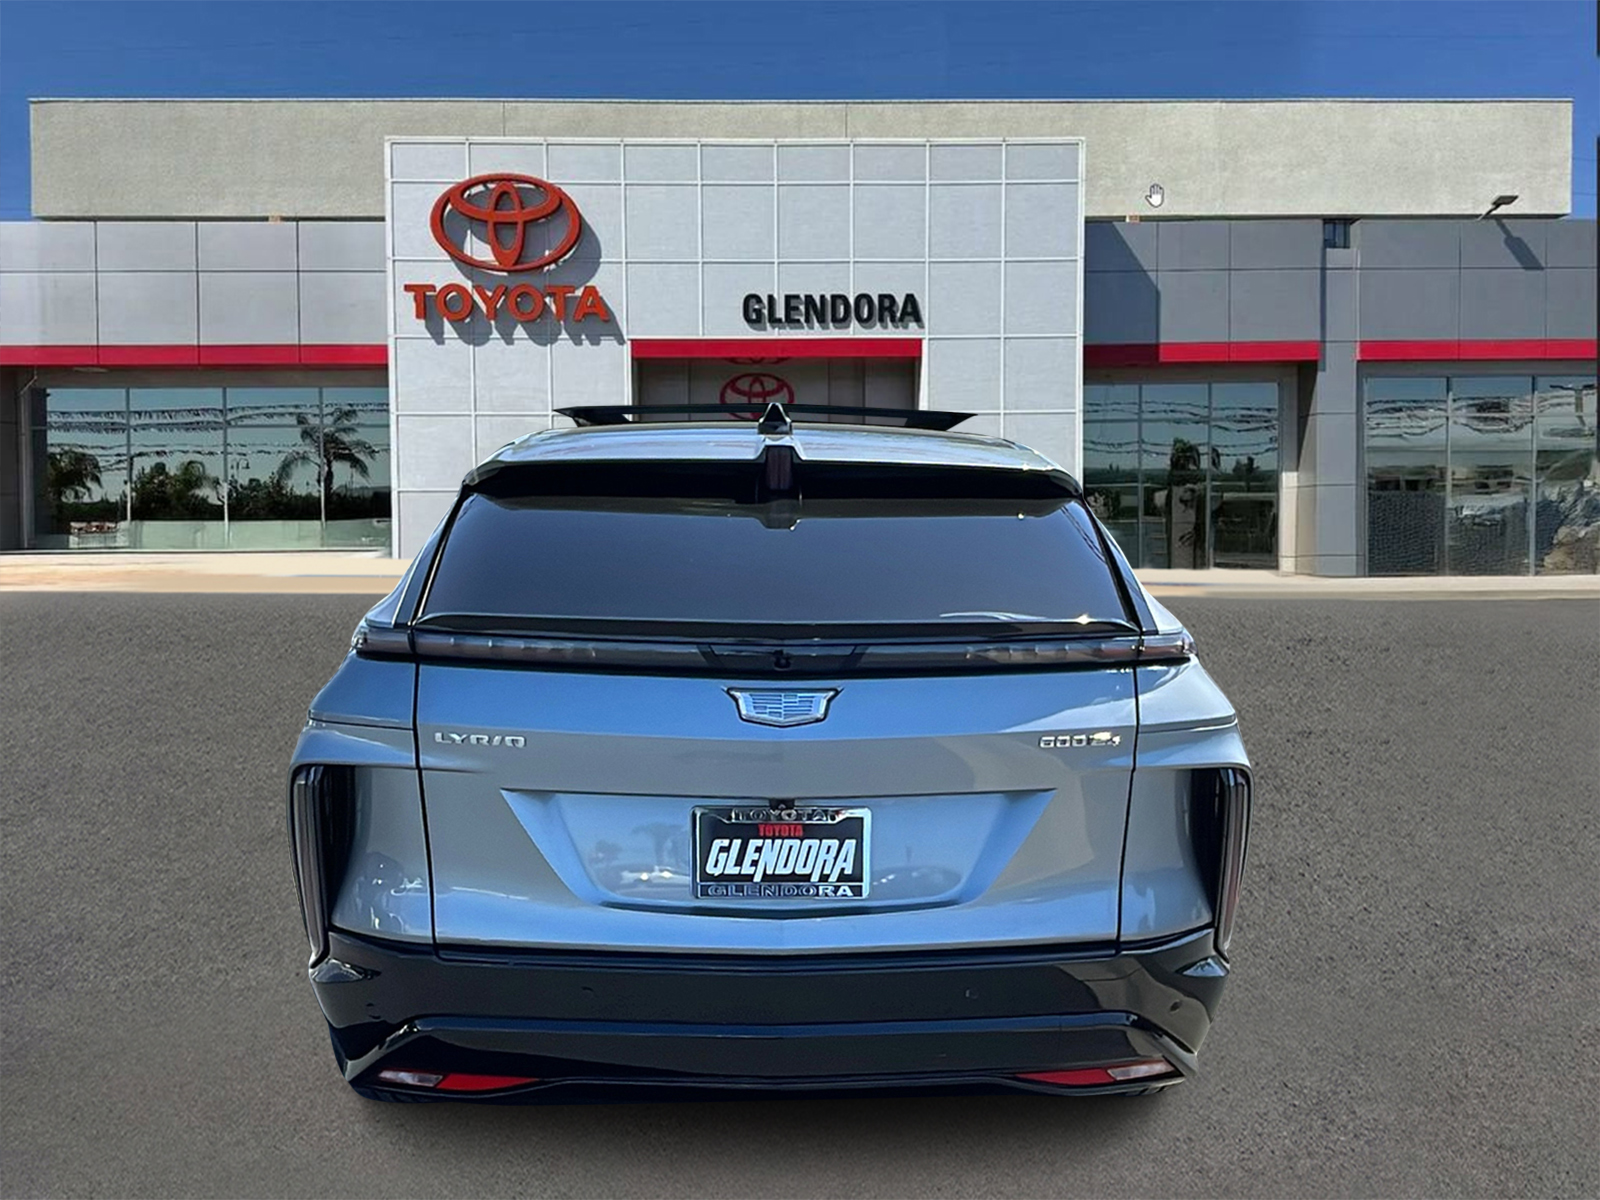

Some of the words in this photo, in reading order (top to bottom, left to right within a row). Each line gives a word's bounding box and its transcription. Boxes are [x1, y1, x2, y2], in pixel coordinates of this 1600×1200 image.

[404, 283, 610, 323] TOYOTA
[743, 293, 922, 328] GLENDORA
[434, 732, 526, 748] LYRIQ
[734, 808, 827, 822] TOYOTA
[757, 824, 804, 837] TOYOTA
[705, 839, 857, 883] GLENDORA
[707, 885, 854, 897] GLENDORA
